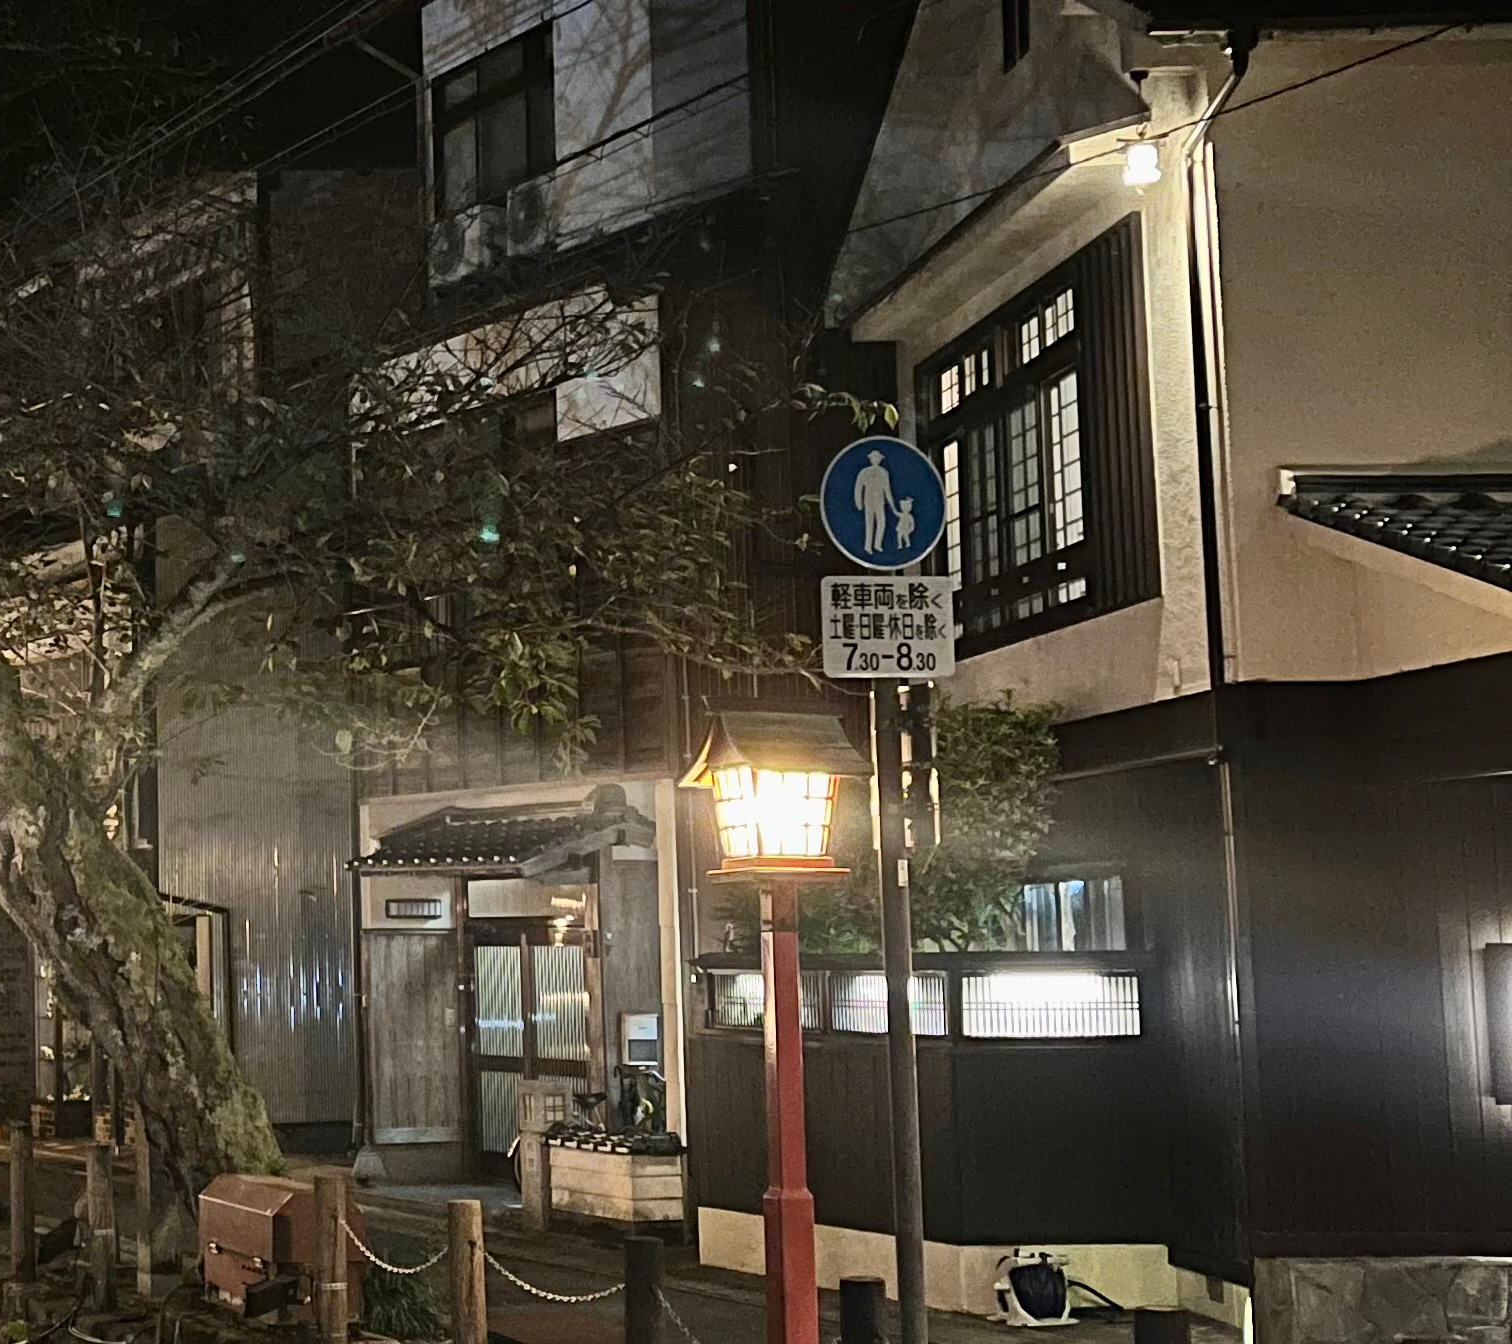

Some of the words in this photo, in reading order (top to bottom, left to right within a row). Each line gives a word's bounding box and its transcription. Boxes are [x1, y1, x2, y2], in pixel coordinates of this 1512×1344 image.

[830, 583, 943, 610] 軽車両を除く
